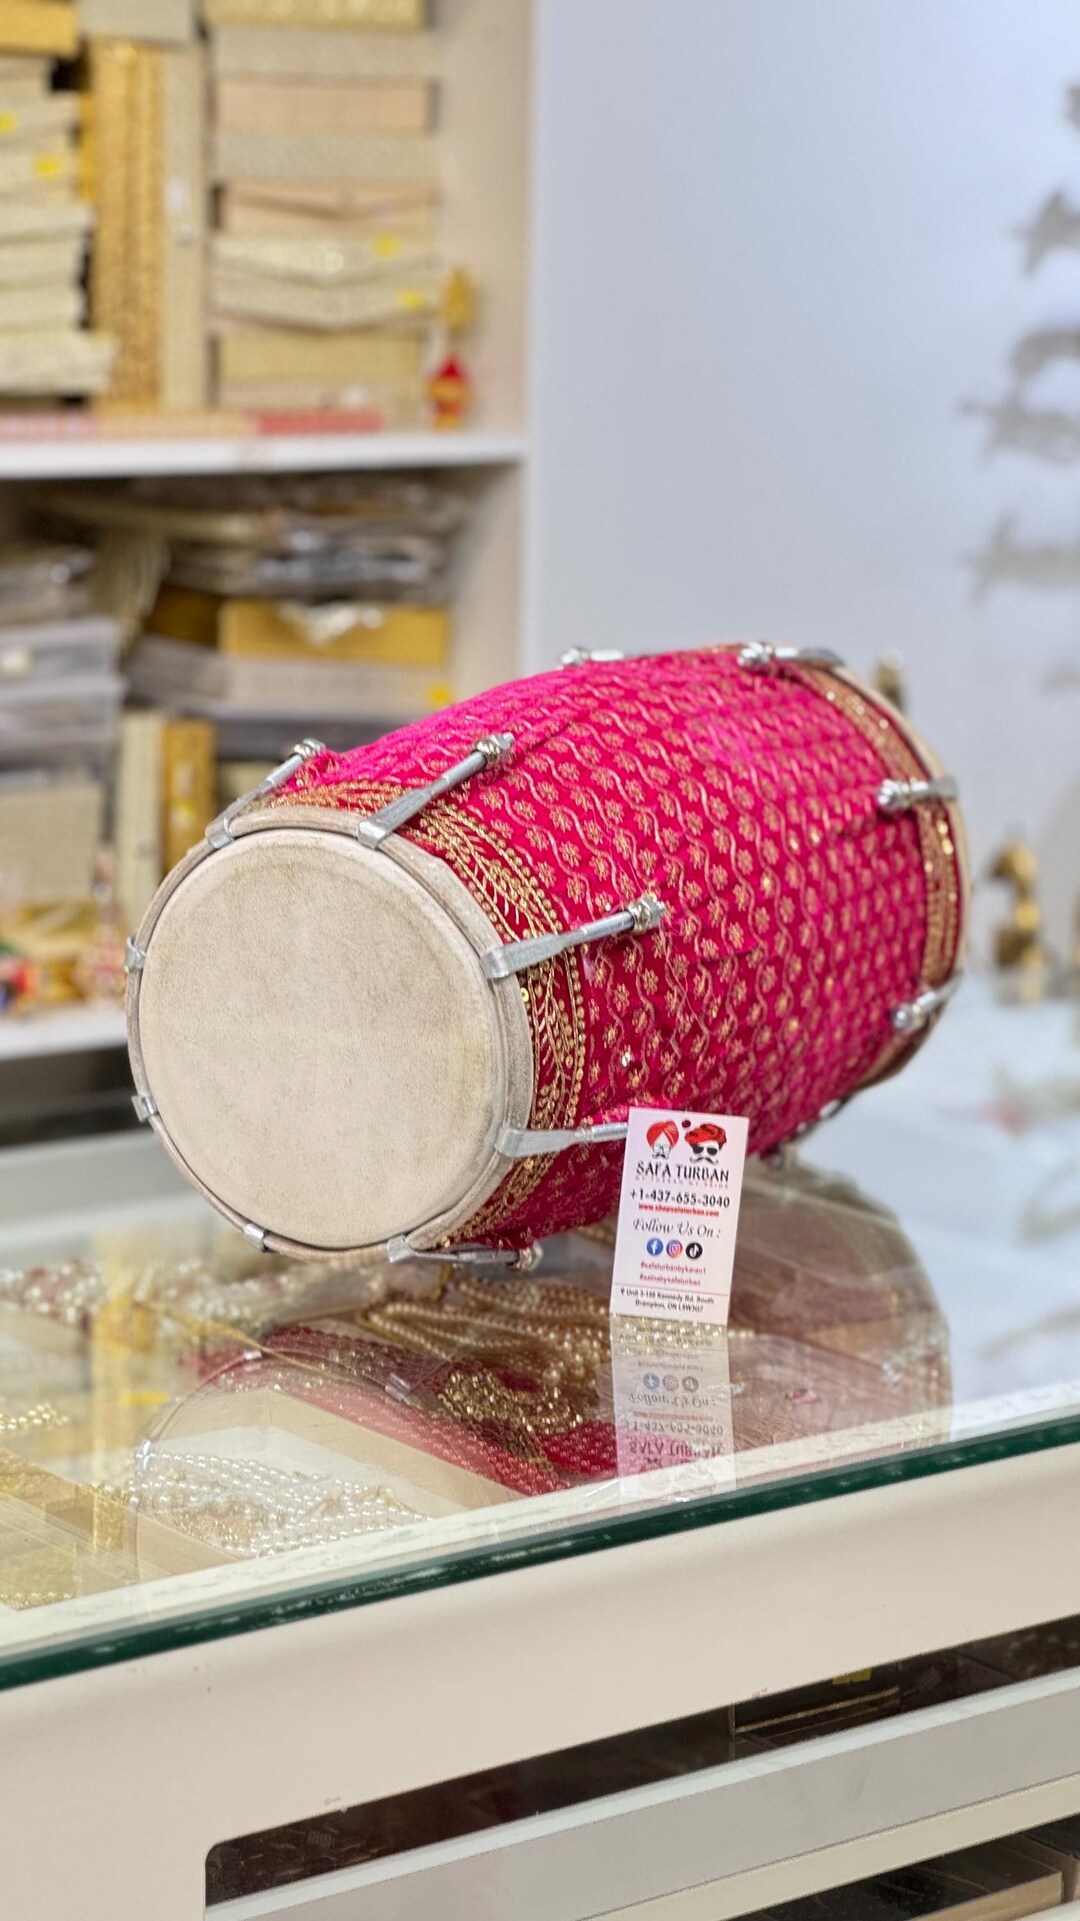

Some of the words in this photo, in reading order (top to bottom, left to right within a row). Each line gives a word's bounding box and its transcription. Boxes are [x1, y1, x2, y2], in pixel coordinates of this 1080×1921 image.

[636, 1160, 671, 1178] SAFA
[676, 1163, 729, 1183] TURBAN
[630, 1187, 730, 1208] +1-437-655-3040
[632, 1216, 674, 1233] Follow
[677, 1220, 693, 1236] Us
